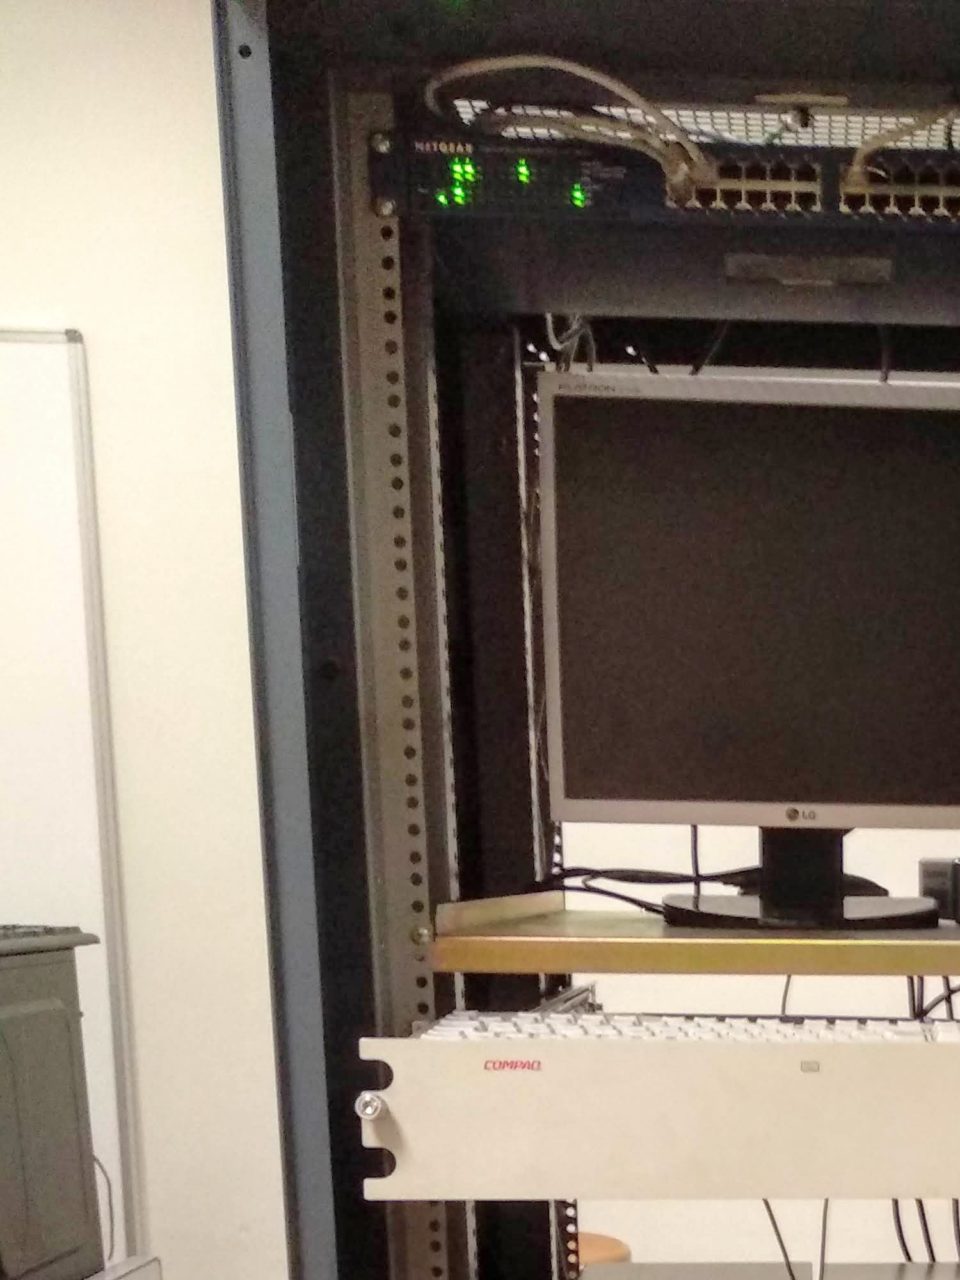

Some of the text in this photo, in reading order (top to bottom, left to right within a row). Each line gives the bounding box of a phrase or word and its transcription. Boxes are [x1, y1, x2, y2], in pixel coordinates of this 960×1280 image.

[415, 141, 473, 153] NETGEAR
[802, 810, 816, 820] LG
[484, 1060, 541, 1071] COMPAQ
